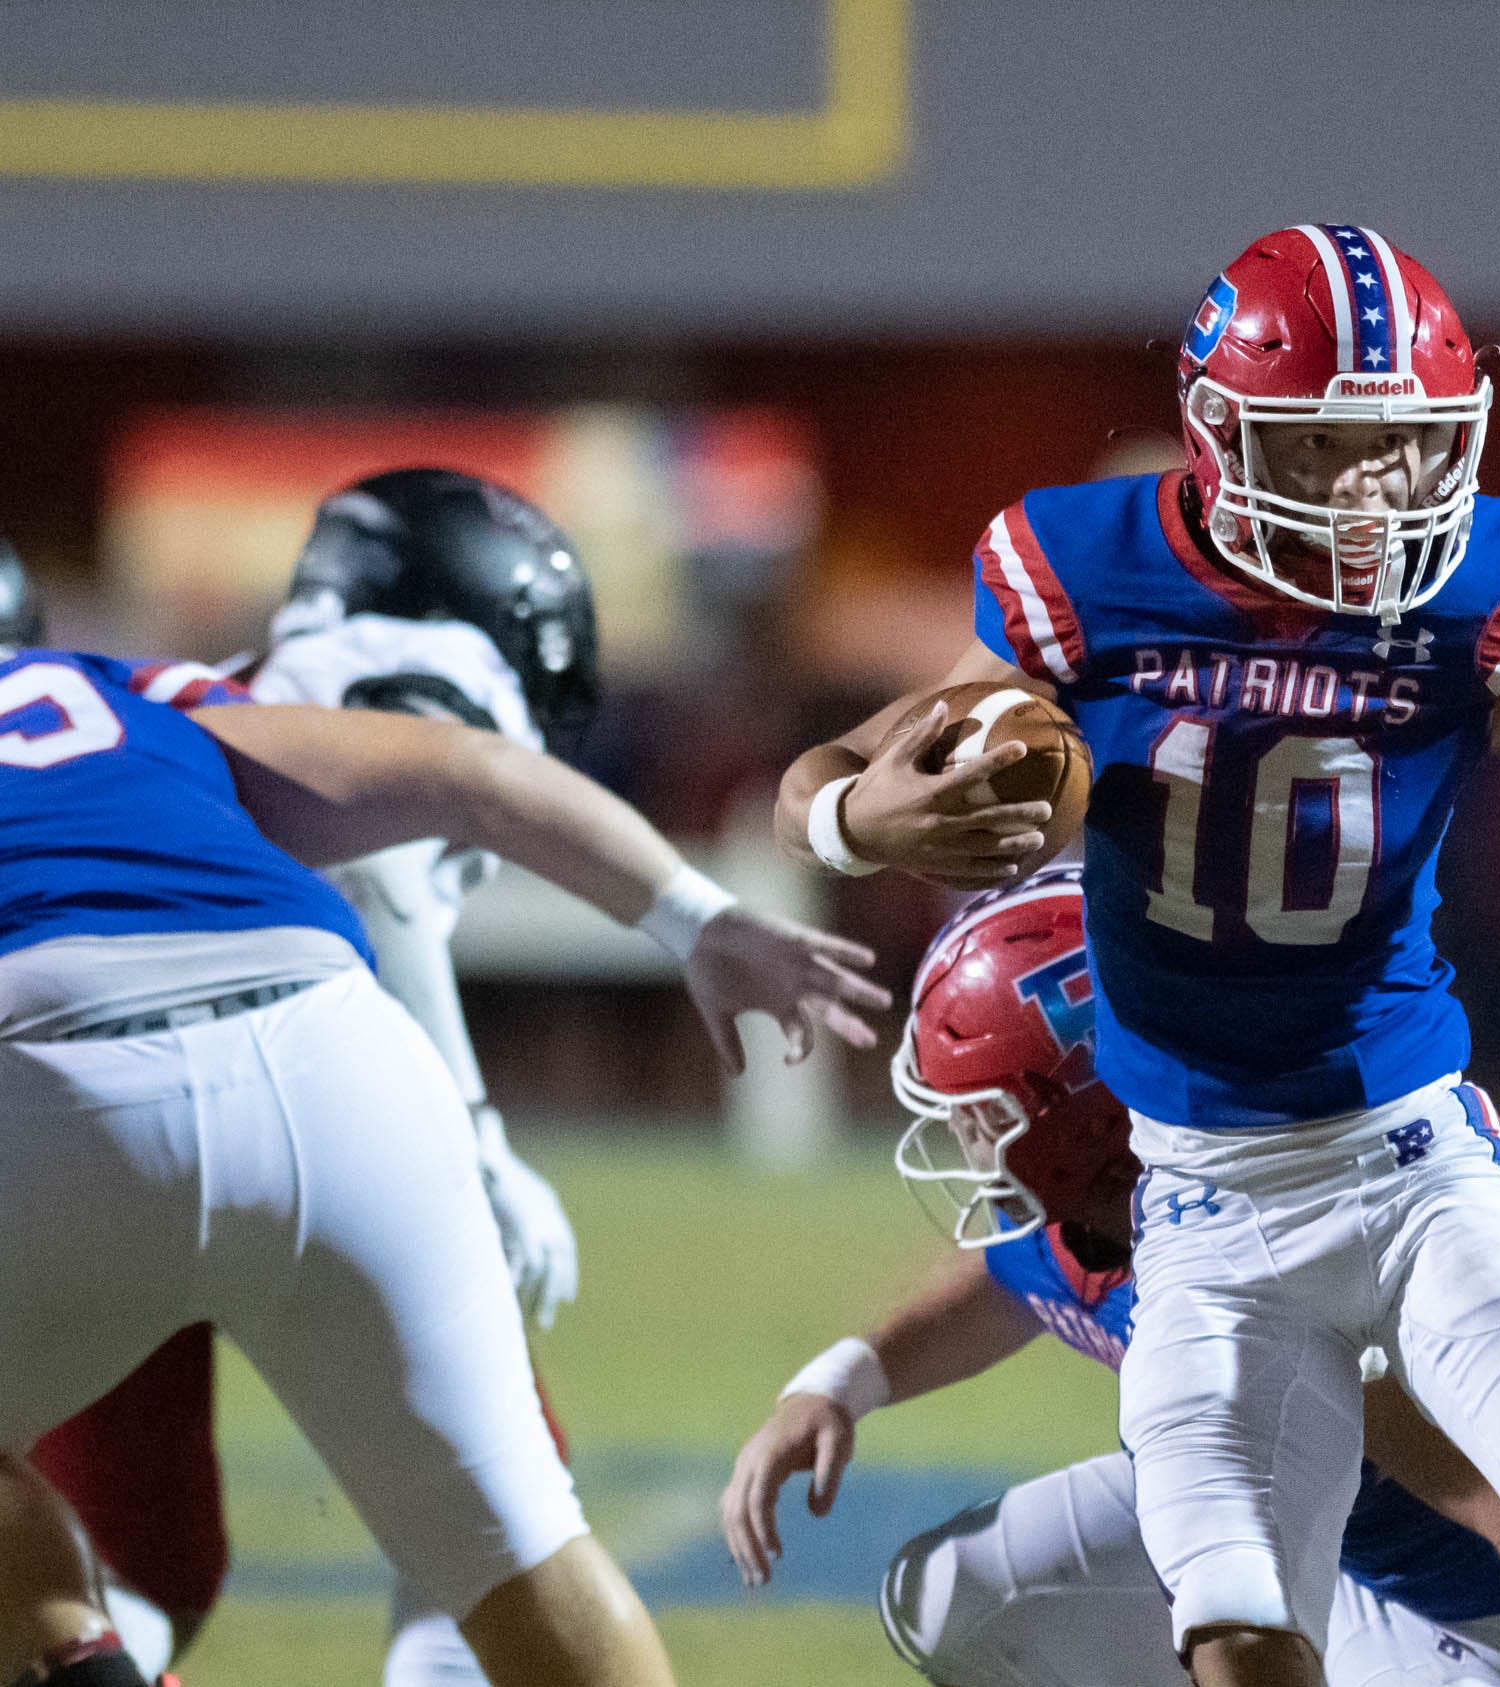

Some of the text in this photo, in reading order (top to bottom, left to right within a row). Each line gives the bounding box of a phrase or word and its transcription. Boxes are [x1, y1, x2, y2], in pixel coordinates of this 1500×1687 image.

[1340, 378, 1415, 396] Riddell
[1131, 649, 1421, 725] PATRIOTS
[1146, 714, 1382, 946] 10
